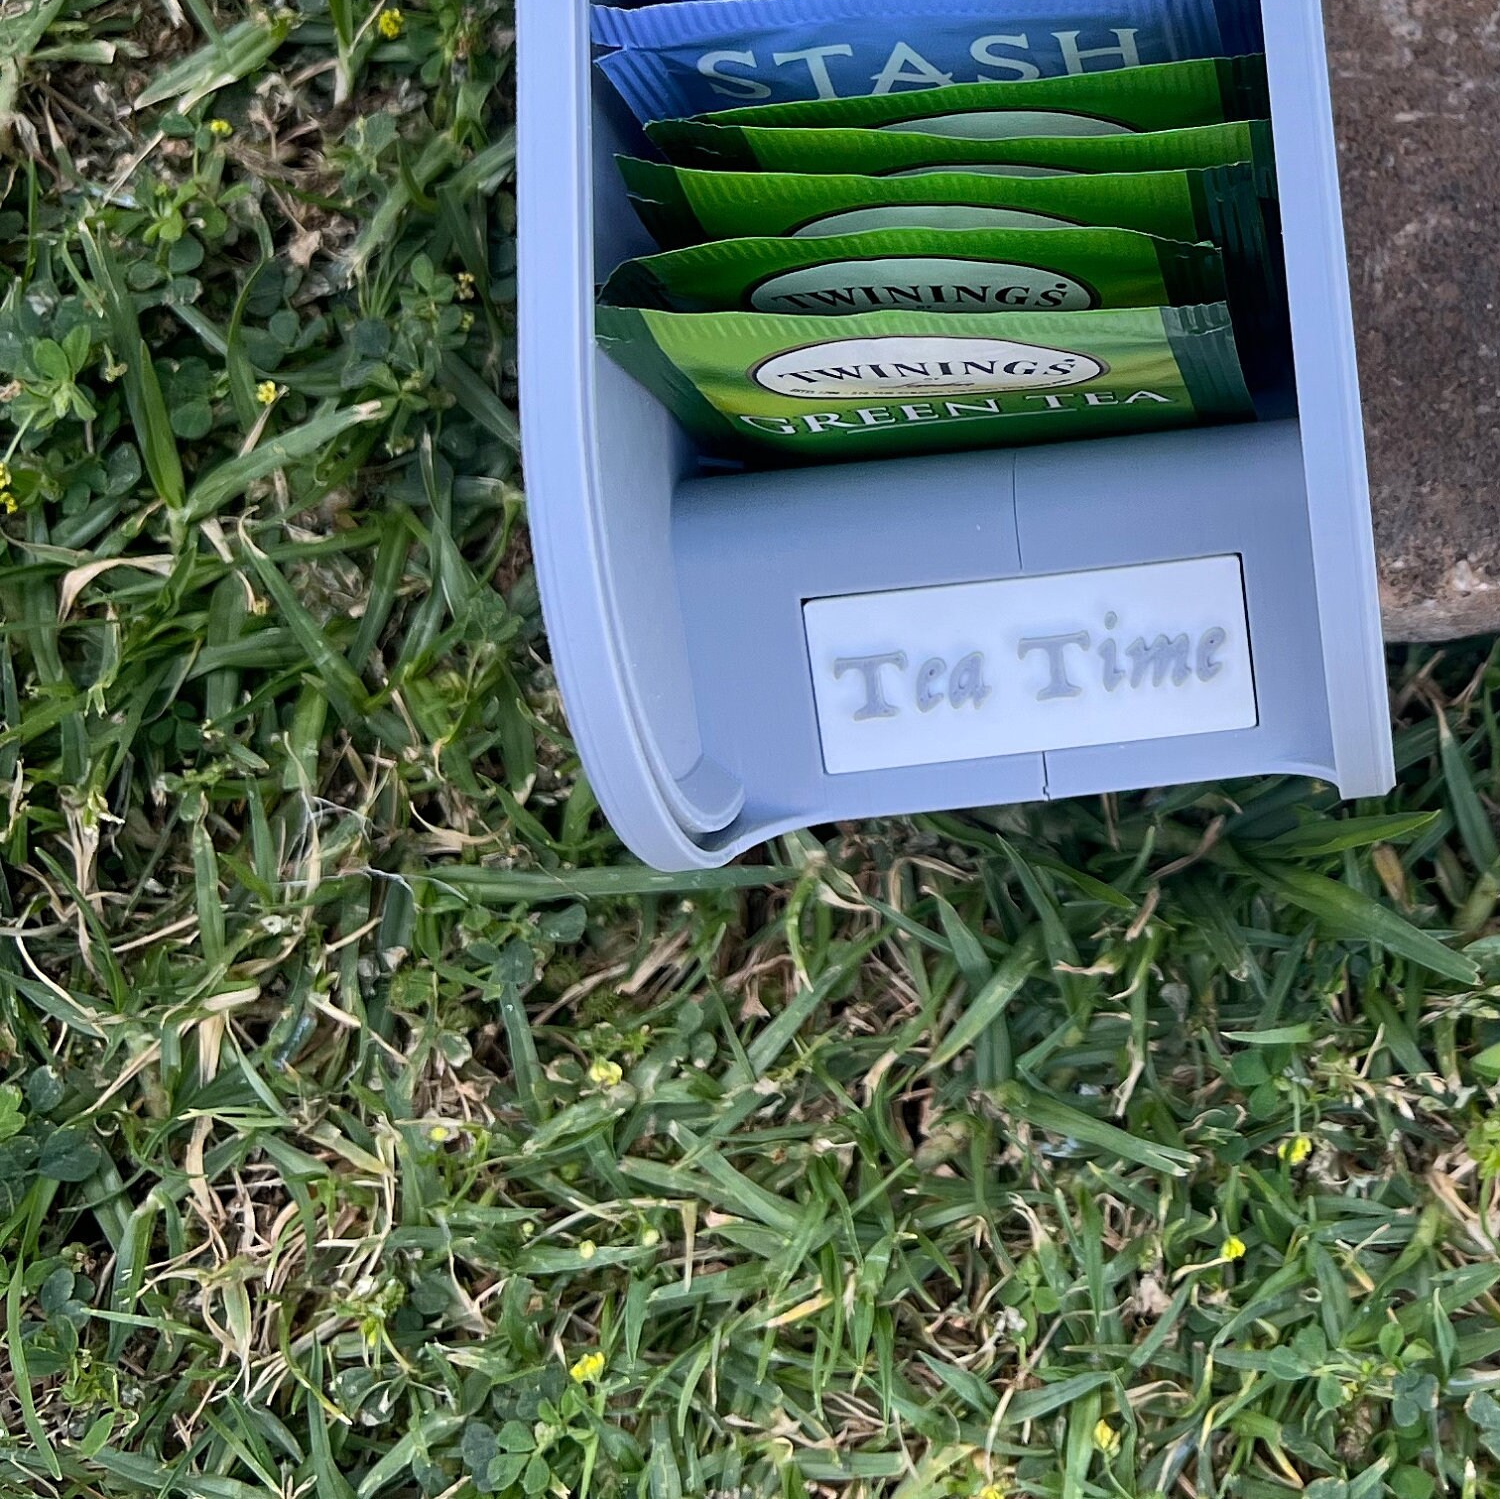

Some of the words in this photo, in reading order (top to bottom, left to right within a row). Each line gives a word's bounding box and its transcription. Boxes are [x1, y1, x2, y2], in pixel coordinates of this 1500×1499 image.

[697, 28, 1139, 100] STASH
[771, 283, 1069, 309] TWININGS
[777, 358, 1076, 384] TWININGS
[740, 399, 1001, 435] GREEN
[1025, 390, 1175, 409] TEA
[832, 649, 992, 722] Tea
[1017, 610, 1228, 702] Time
